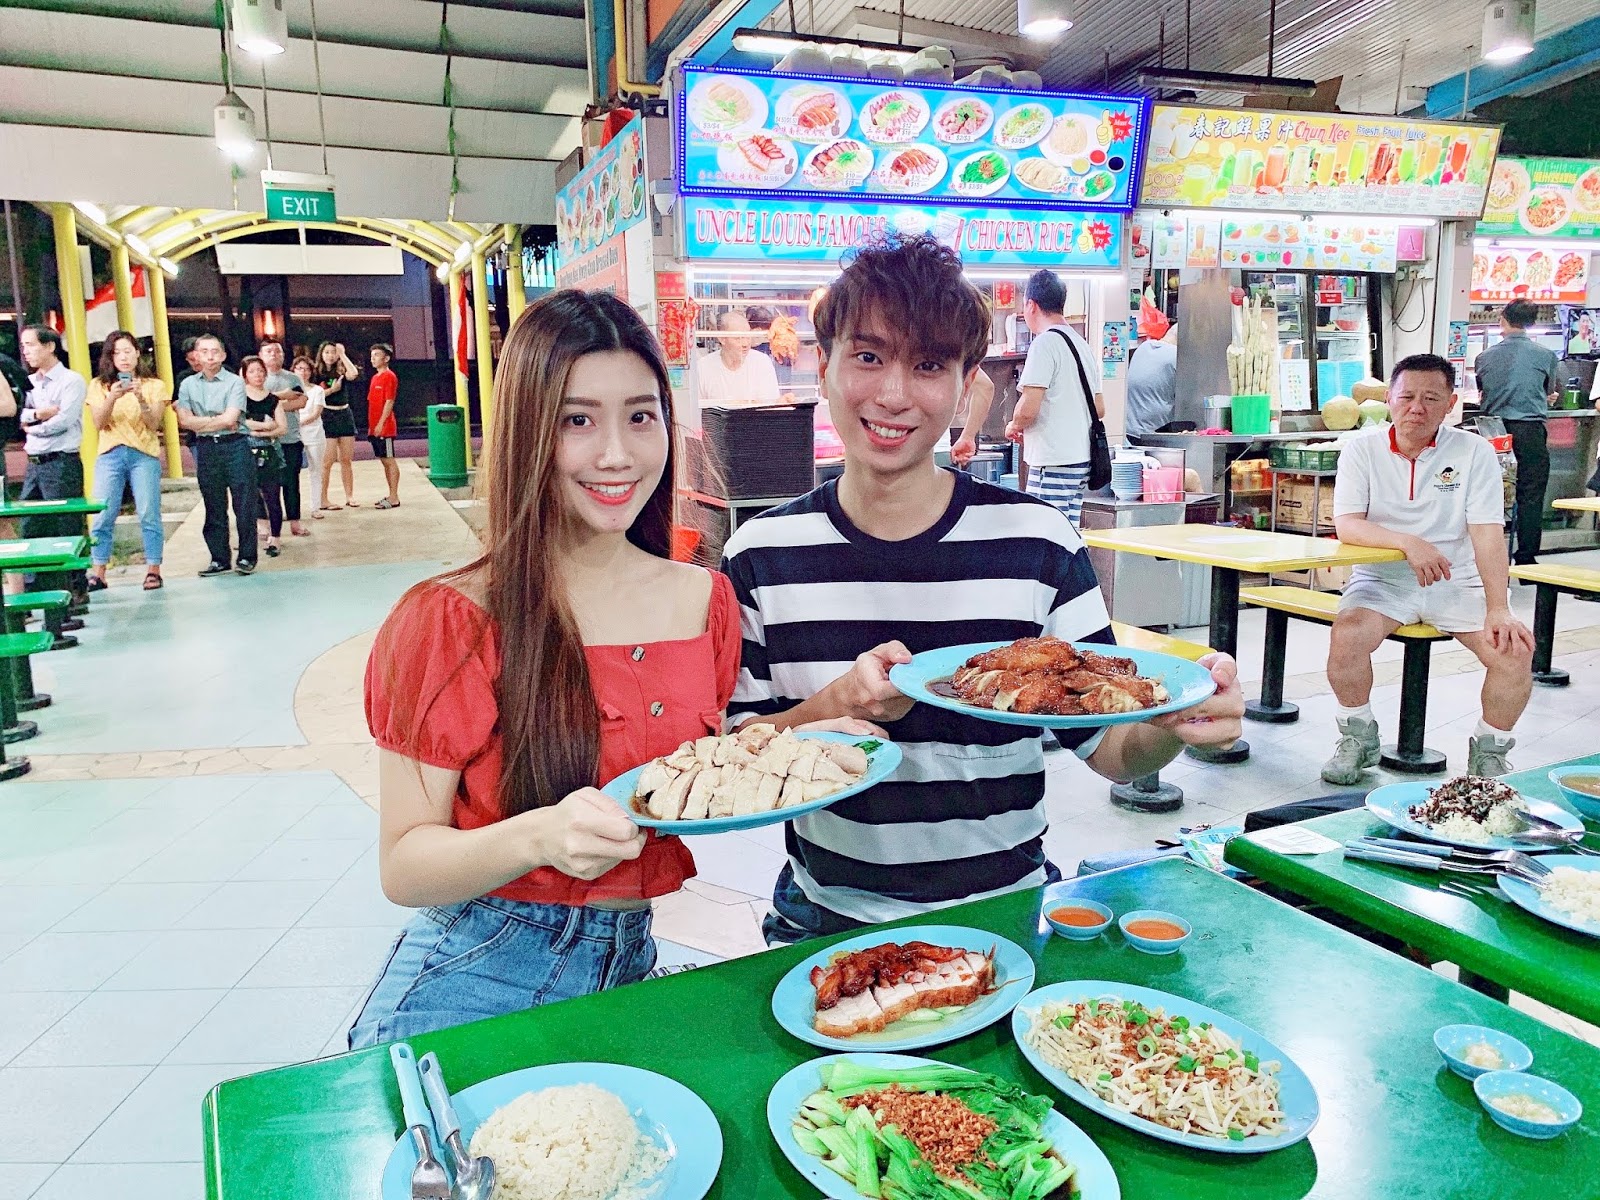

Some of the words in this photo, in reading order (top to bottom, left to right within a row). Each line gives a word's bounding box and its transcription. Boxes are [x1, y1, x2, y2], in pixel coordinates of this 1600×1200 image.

[1294, 120, 1326, 143] Chun
[1328, 123, 1350, 143] Kee
[1356, 125, 1379, 137] Fresh
[282, 196, 319, 216] EXIT
[696, 209, 756, 244] UNCLE
[761, 211, 812, 246] LOUIS
[967, 219, 1036, 252] CHICKEN
[1038, 222, 1073, 253] RICE
